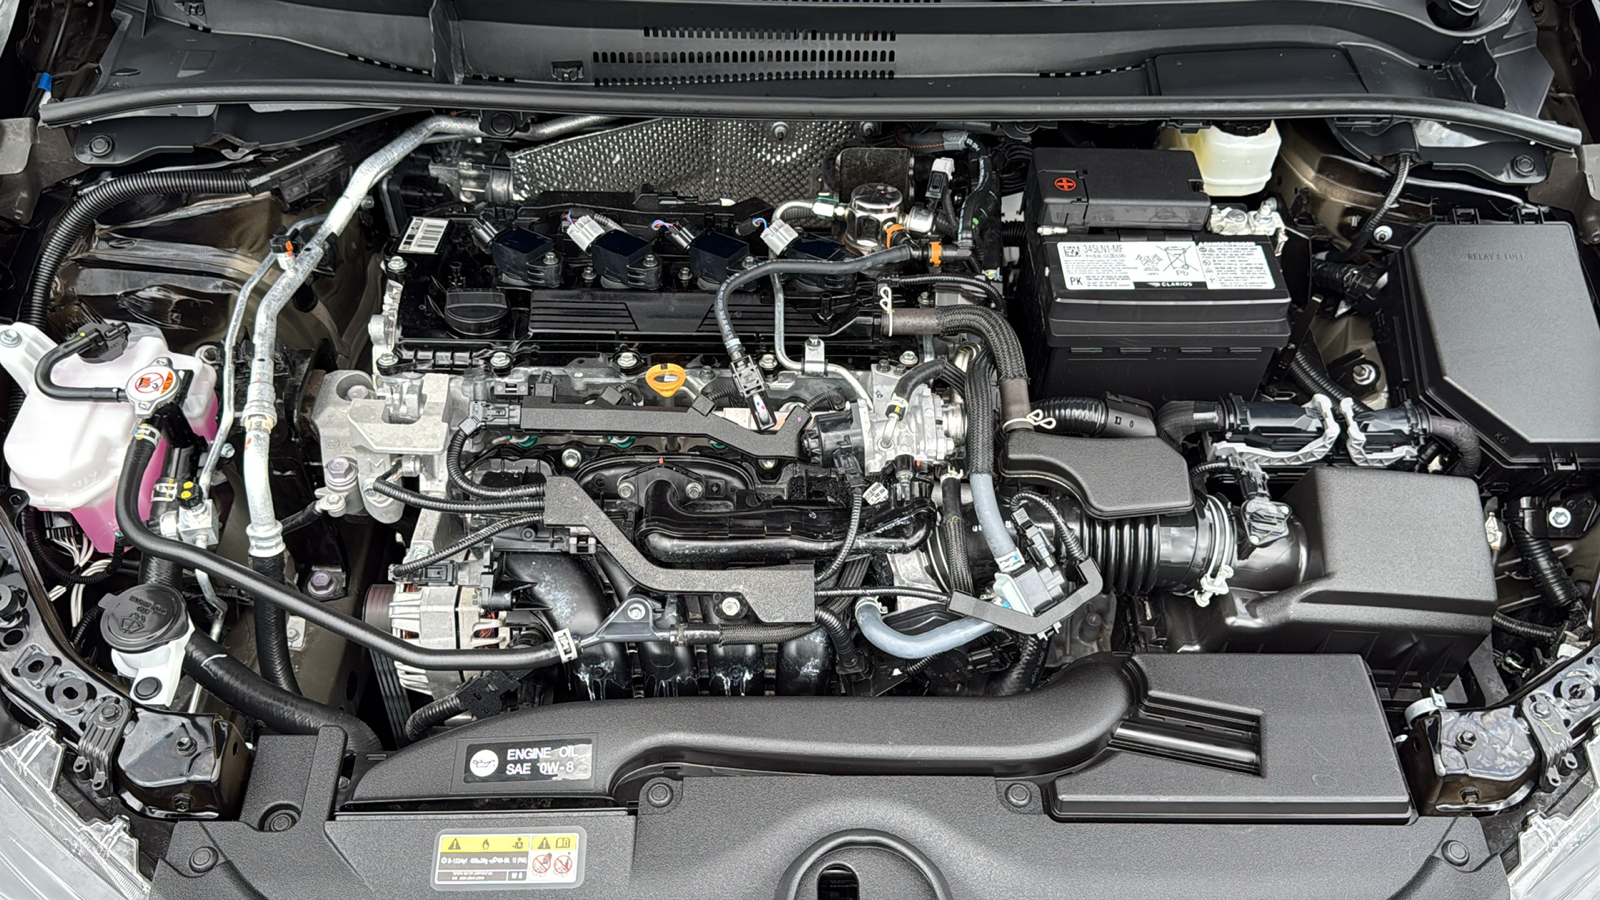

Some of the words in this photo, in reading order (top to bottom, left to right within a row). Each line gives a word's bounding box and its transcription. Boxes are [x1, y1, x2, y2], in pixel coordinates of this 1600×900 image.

[1070, 276, 1083, 286] PK
[507, 747, 552, 760] ENGINE
[558, 745, 579, 758] OIL
[505, 763, 532, 775] SAE
[539, 761, 574, 775] 0W-8
